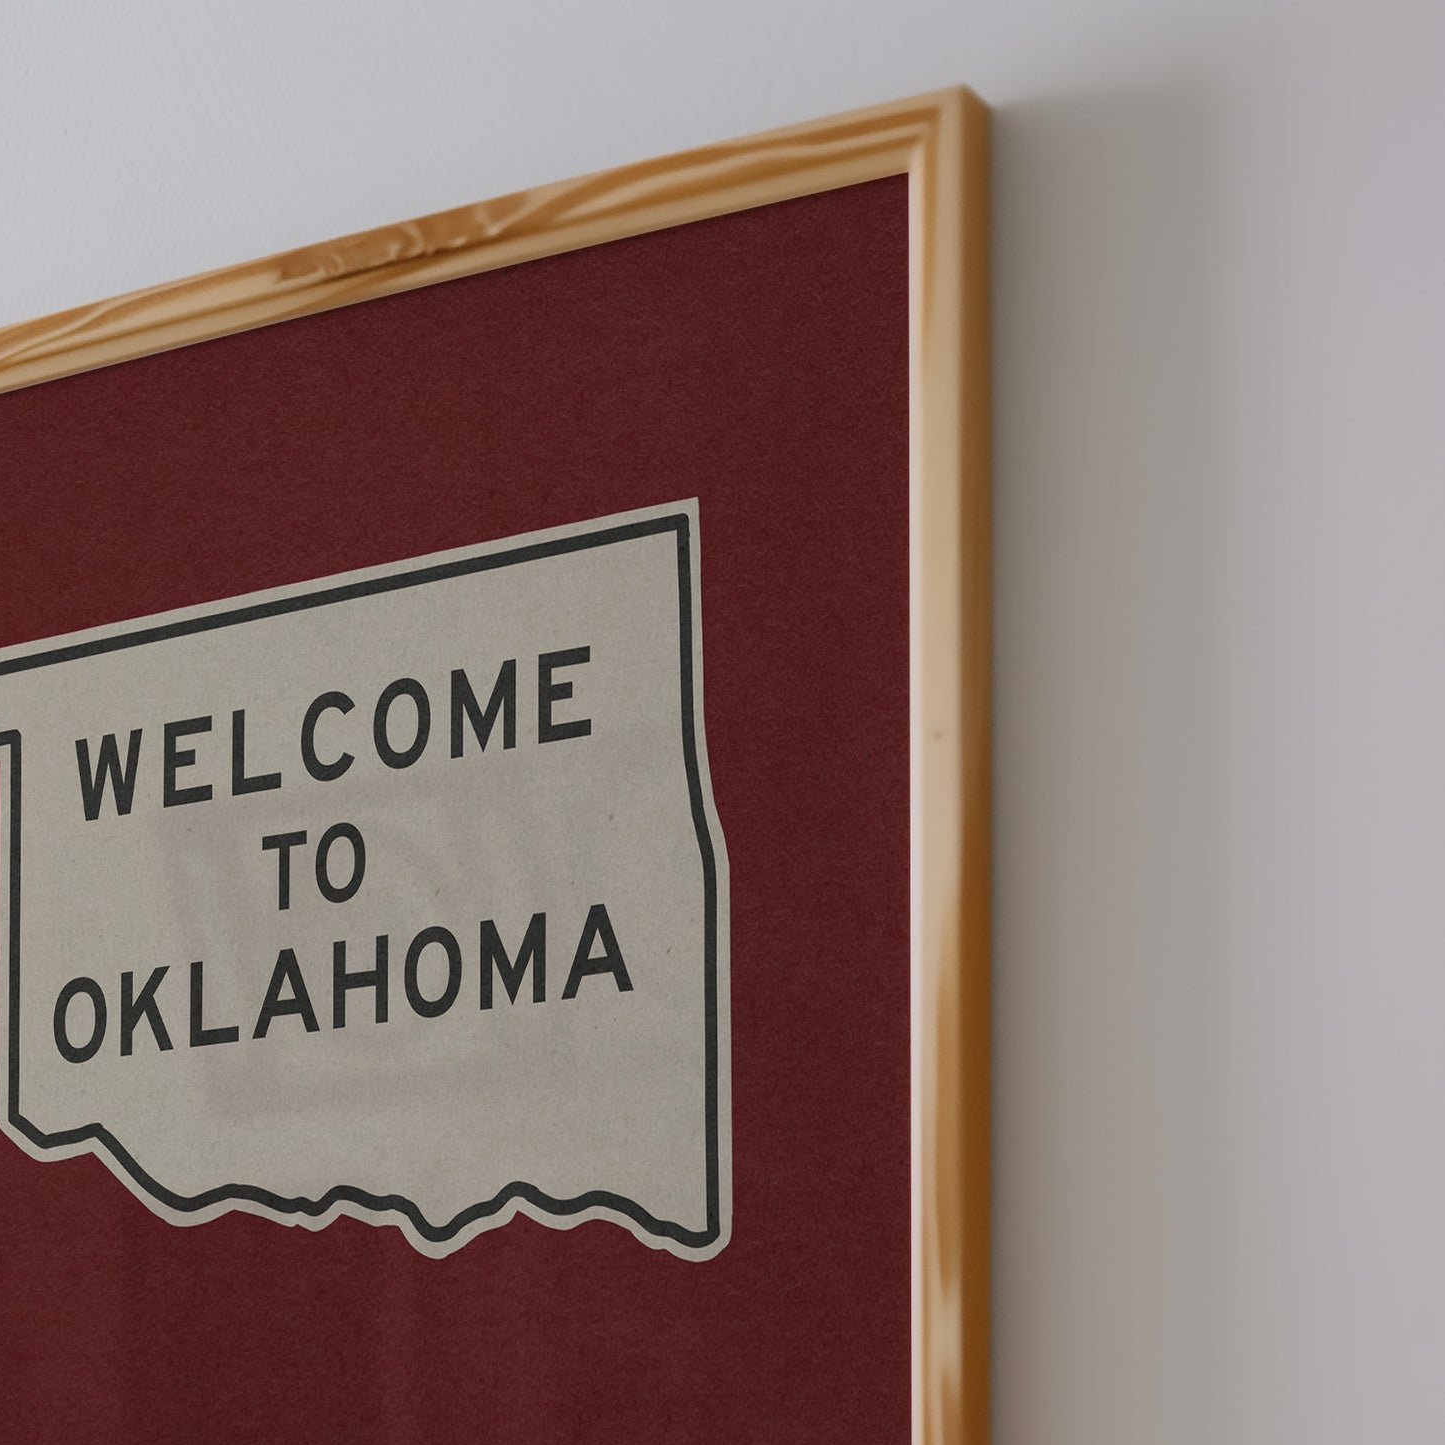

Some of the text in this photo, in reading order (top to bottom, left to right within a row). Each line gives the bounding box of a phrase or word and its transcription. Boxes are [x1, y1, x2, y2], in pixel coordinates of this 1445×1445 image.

[75, 646, 592, 822] WELCOME
[261, 822, 367, 911] TO
[53, 903, 634, 1064] OKLAHOMA
